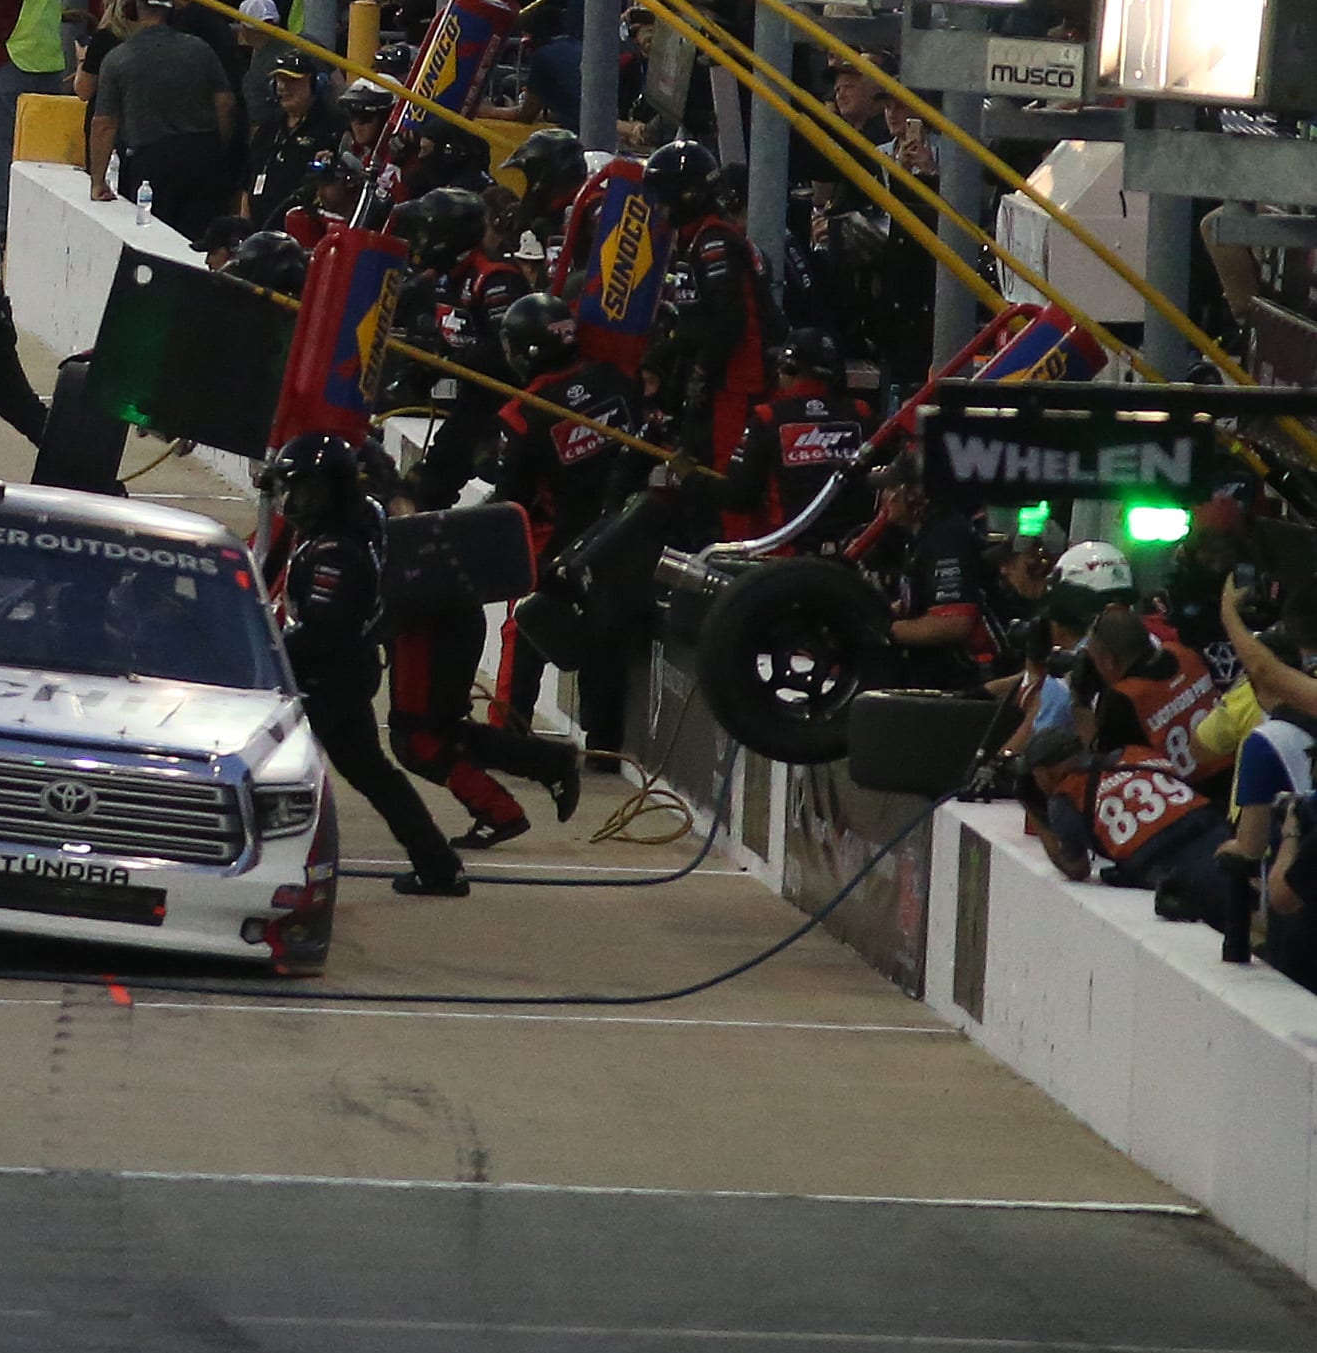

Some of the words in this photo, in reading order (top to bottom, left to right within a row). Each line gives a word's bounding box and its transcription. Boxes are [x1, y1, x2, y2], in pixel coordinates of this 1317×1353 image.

[602, 197, 650, 318] SUNOCO
[944, 431, 1194, 486] WHELEN
[34, 532, 219, 576] OUTDOORS
[0, 853, 130, 886] TUNDRA
